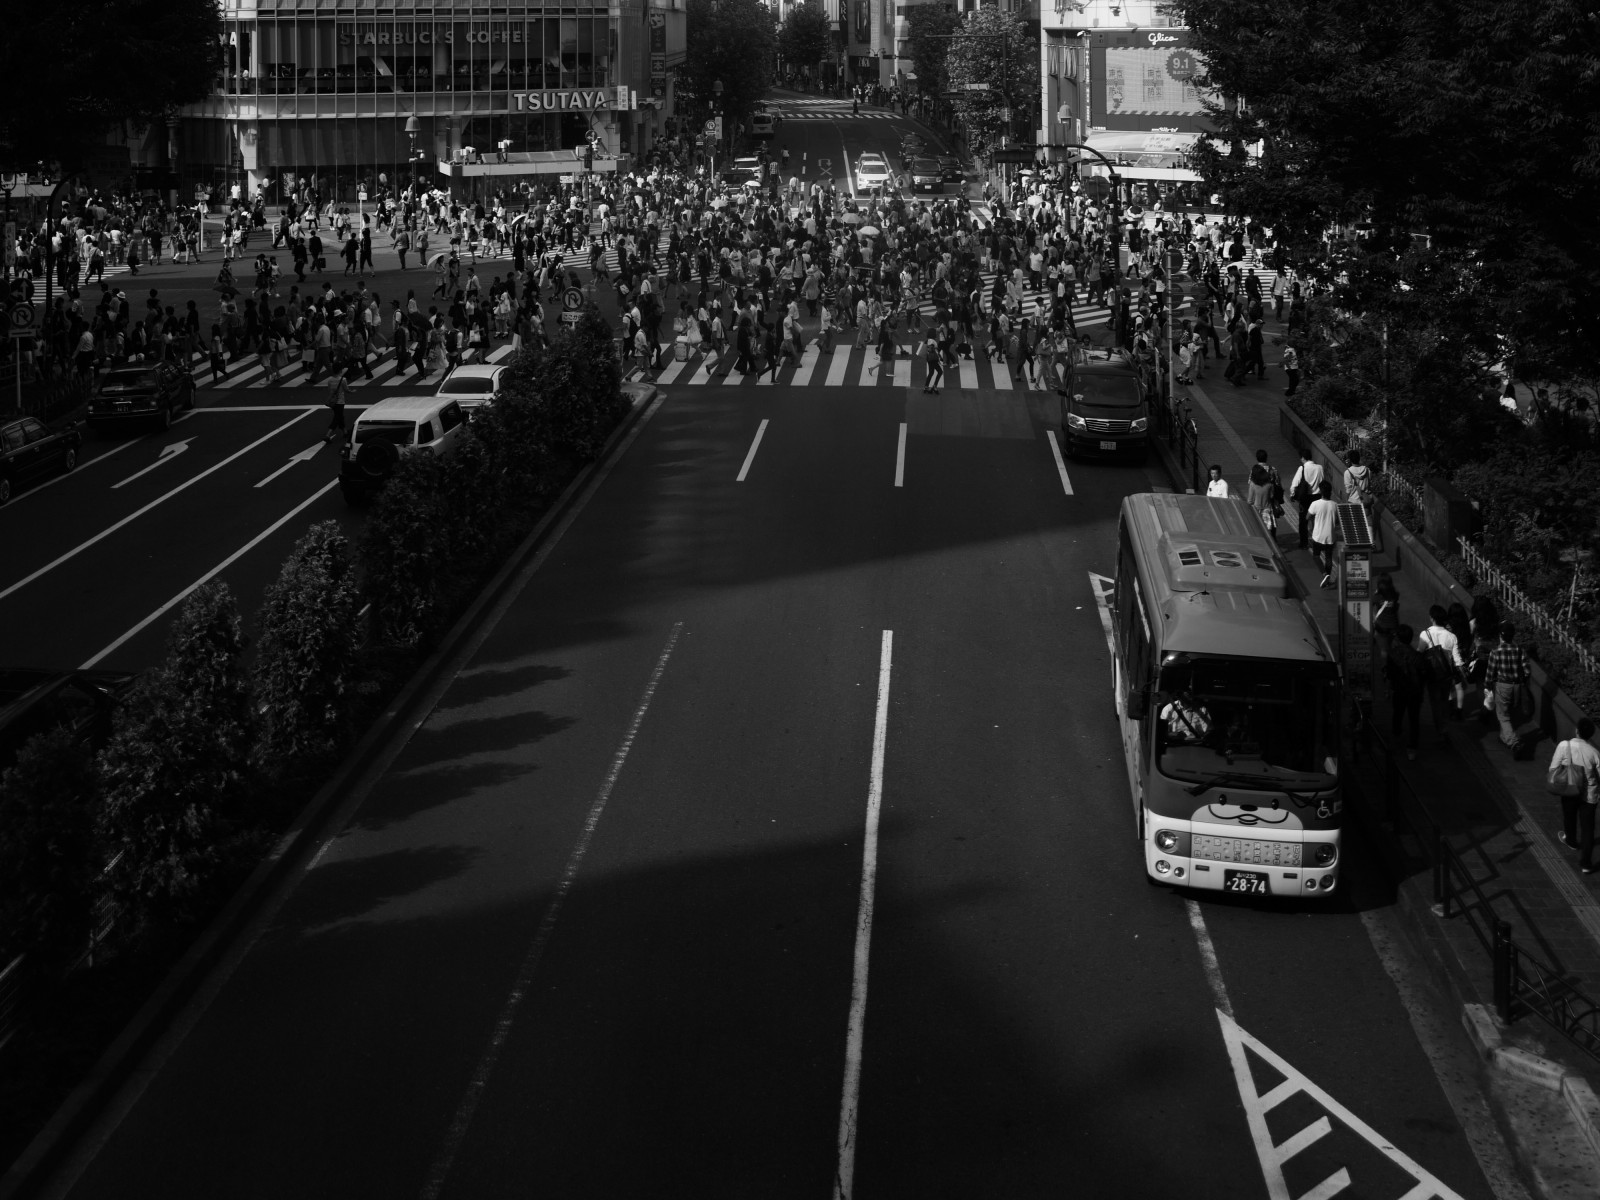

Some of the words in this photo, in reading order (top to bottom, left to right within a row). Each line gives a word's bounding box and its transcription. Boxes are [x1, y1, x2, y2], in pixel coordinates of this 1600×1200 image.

[339, 31, 453, 46] STARBUCKS
[466, 30, 530, 44] COFFEE
[1148, 32, 1179, 46] Glico
[1173, 57, 1189, 69] 9.1
[512, 91, 606, 111] TSUTAYA
[1231, 877, 1266, 894] 28-74
